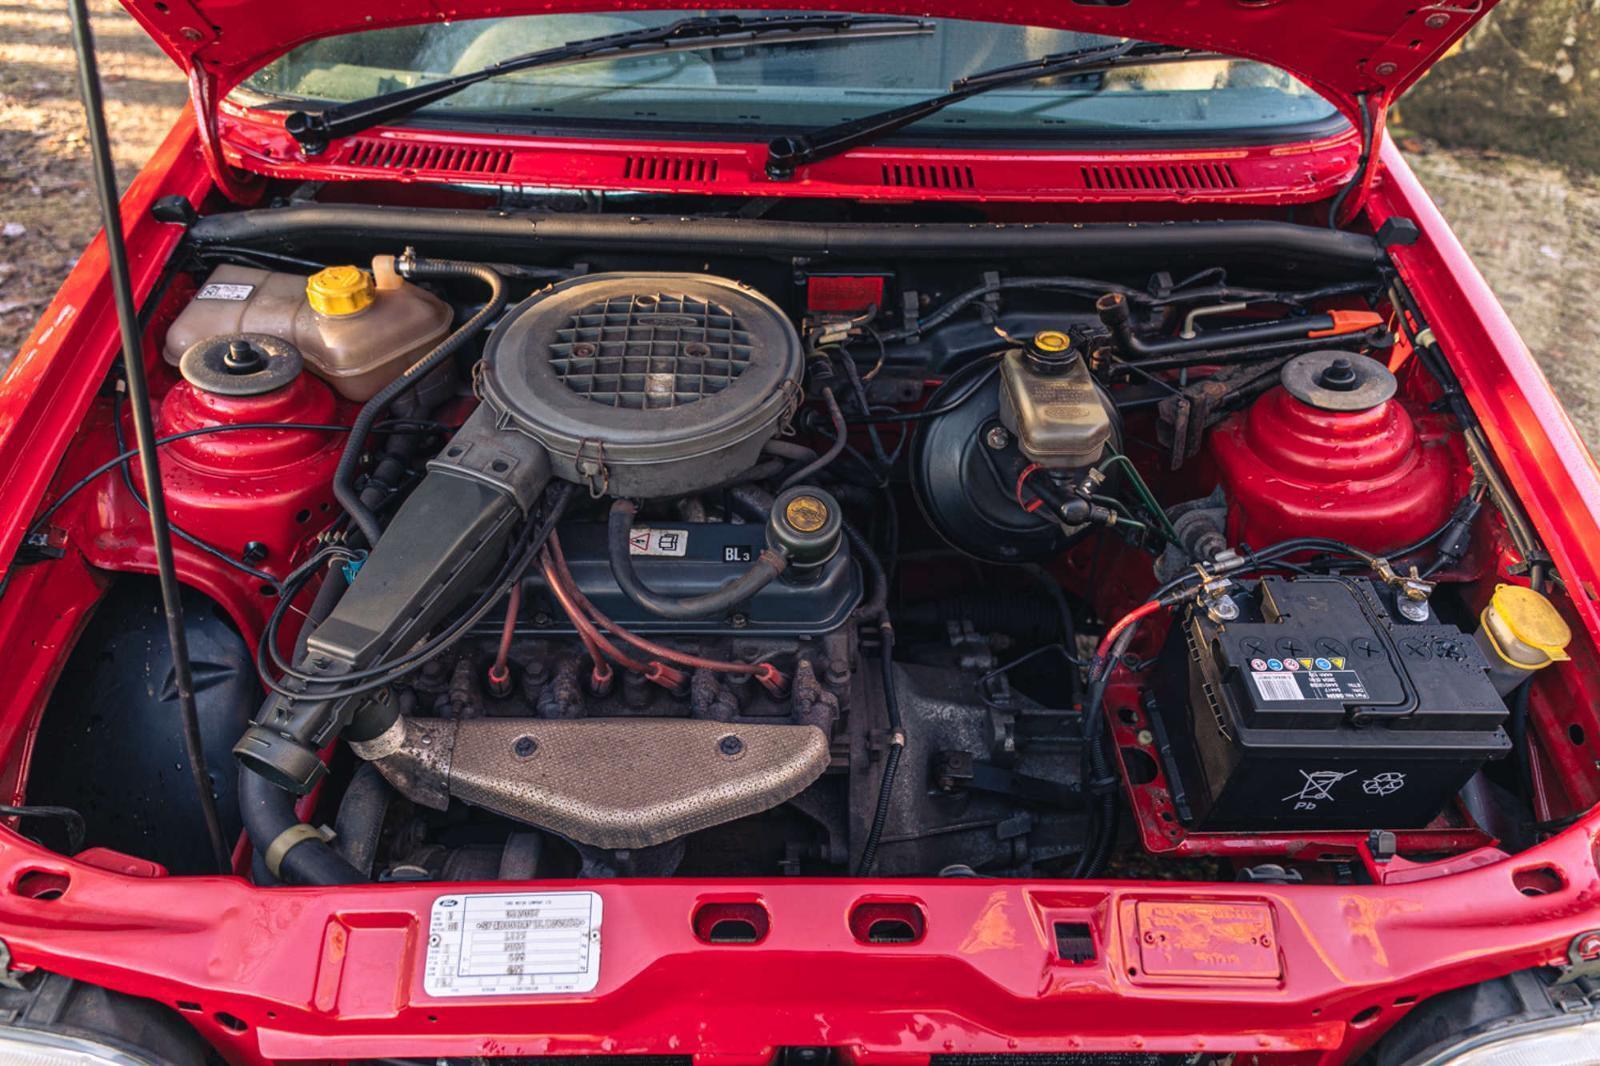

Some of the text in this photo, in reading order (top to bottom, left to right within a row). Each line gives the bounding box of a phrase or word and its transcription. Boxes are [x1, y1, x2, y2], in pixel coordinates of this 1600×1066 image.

[725, 547, 750, 561] BL 3
[1294, 801, 1317, 810] Pb
